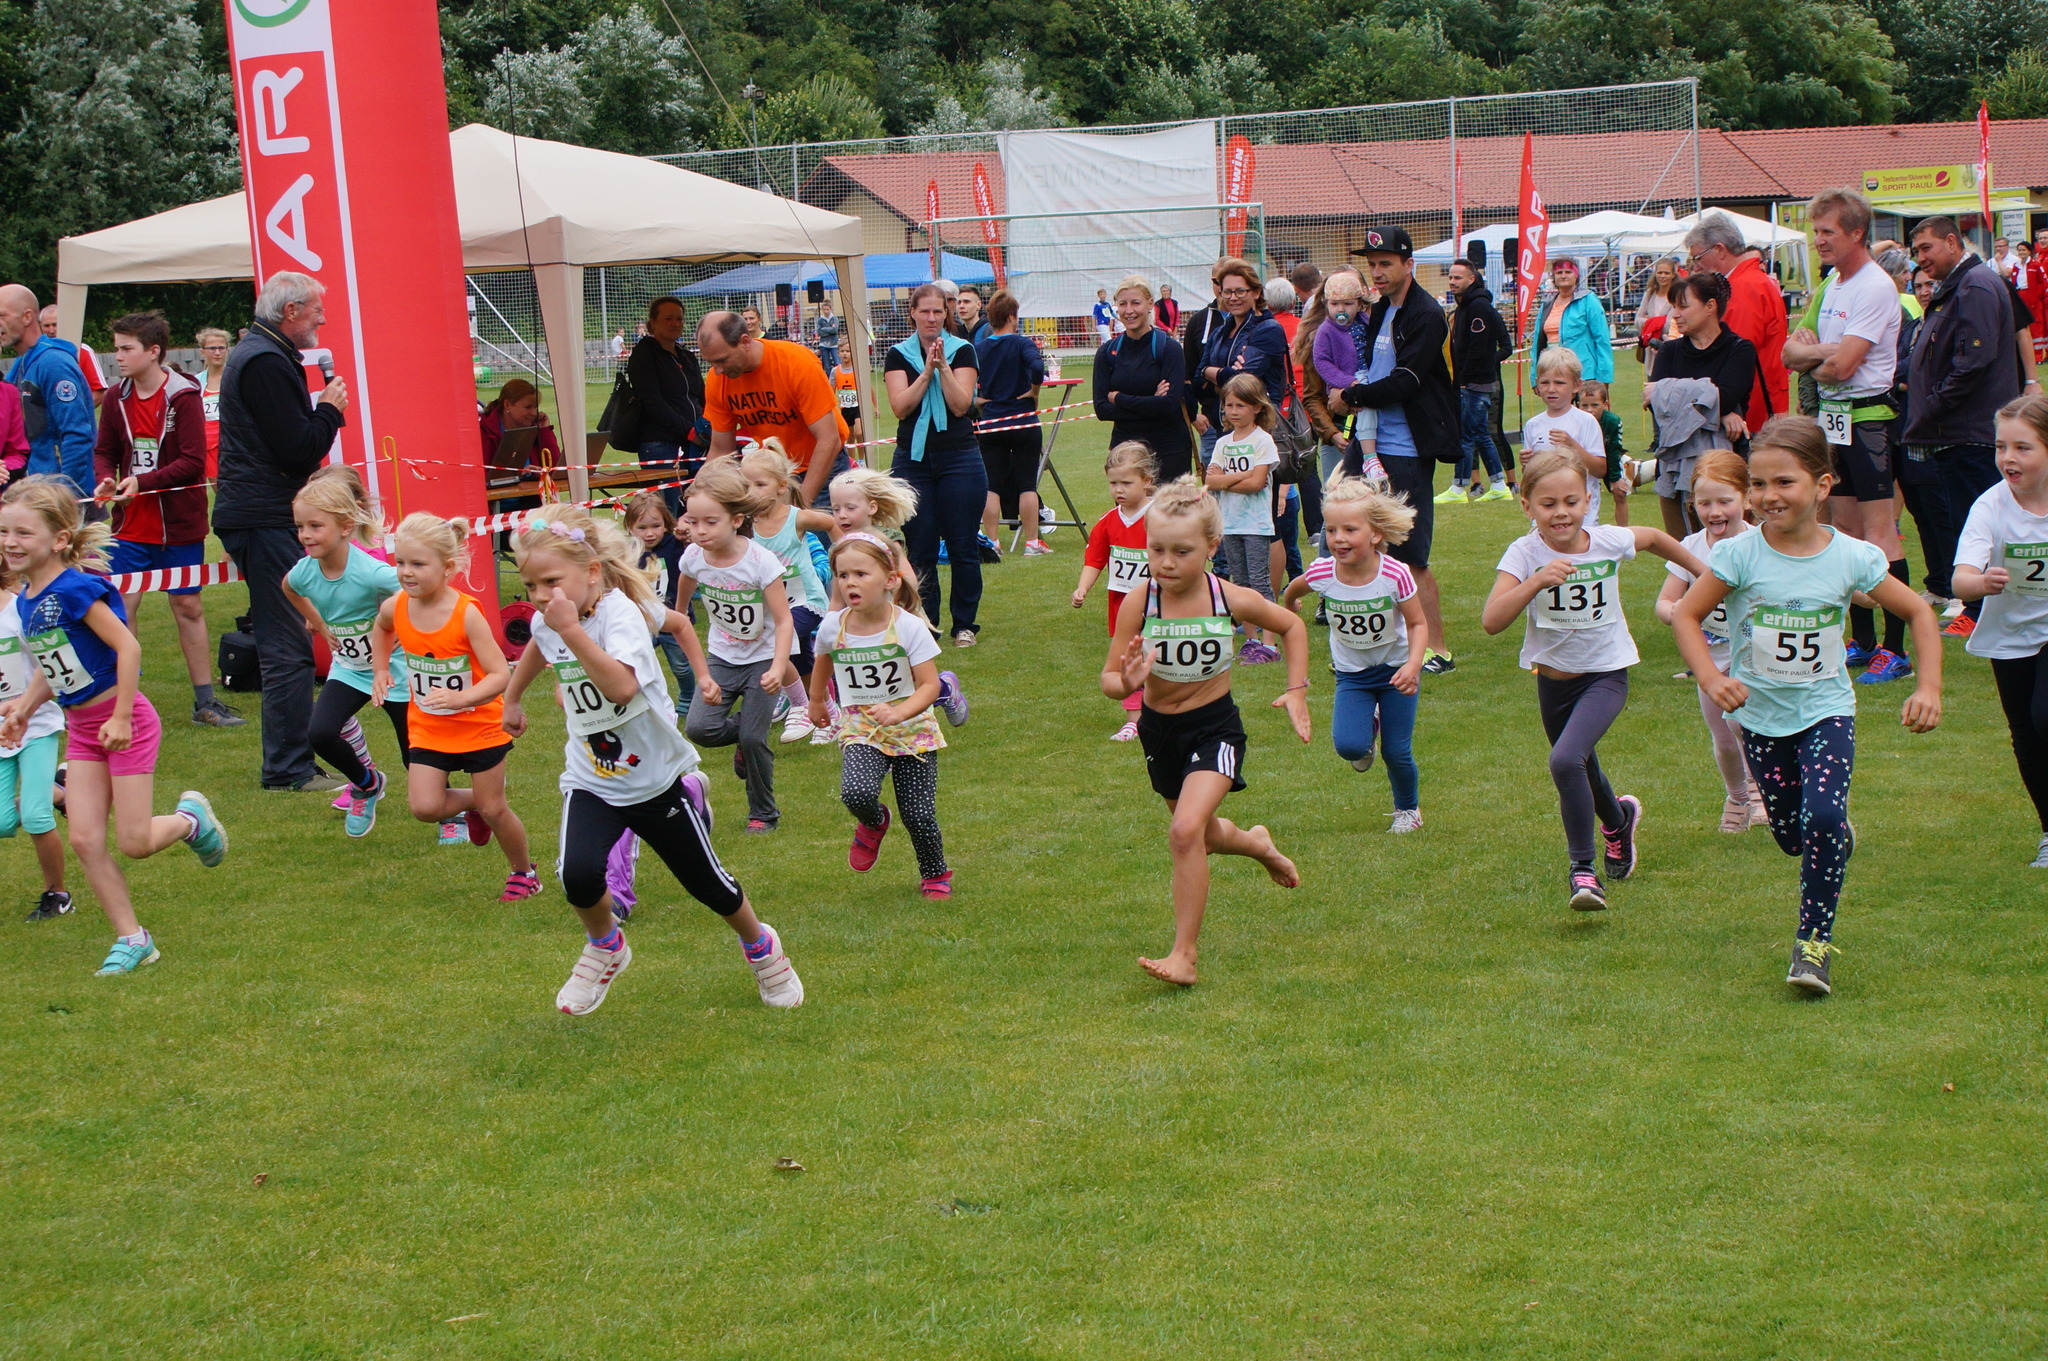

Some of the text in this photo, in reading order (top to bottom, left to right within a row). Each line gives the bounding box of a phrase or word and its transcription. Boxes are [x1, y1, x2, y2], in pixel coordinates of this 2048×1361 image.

[728, 391, 777, 411] NATUR
[1826, 413, 1845, 432] 36
[132, 450, 154, 467] 13
[1113, 549, 1142, 560] erima
[1114, 559, 1152, 581] 274
[2026, 560, 2045, 581] 2
[705, 587, 739, 602] erima
[1547, 581, 1607, 612] 131
[708, 599, 755, 626] 230
[1329, 601, 1368, 613] erima
[1151, 622, 1202, 636] erima
[1333, 613, 1386, 636] 280
[1762, 612, 1817, 628] erima
[1154, 639, 1221, 666] 109
[1775, 631, 1820, 662] 55
[408, 658, 447, 672] erima
[837, 650, 880, 662] erima
[844, 660, 902, 689] 132
[1156, 669, 1178, 677] SPORT
[1766, 666, 1789, 675] SPORT
